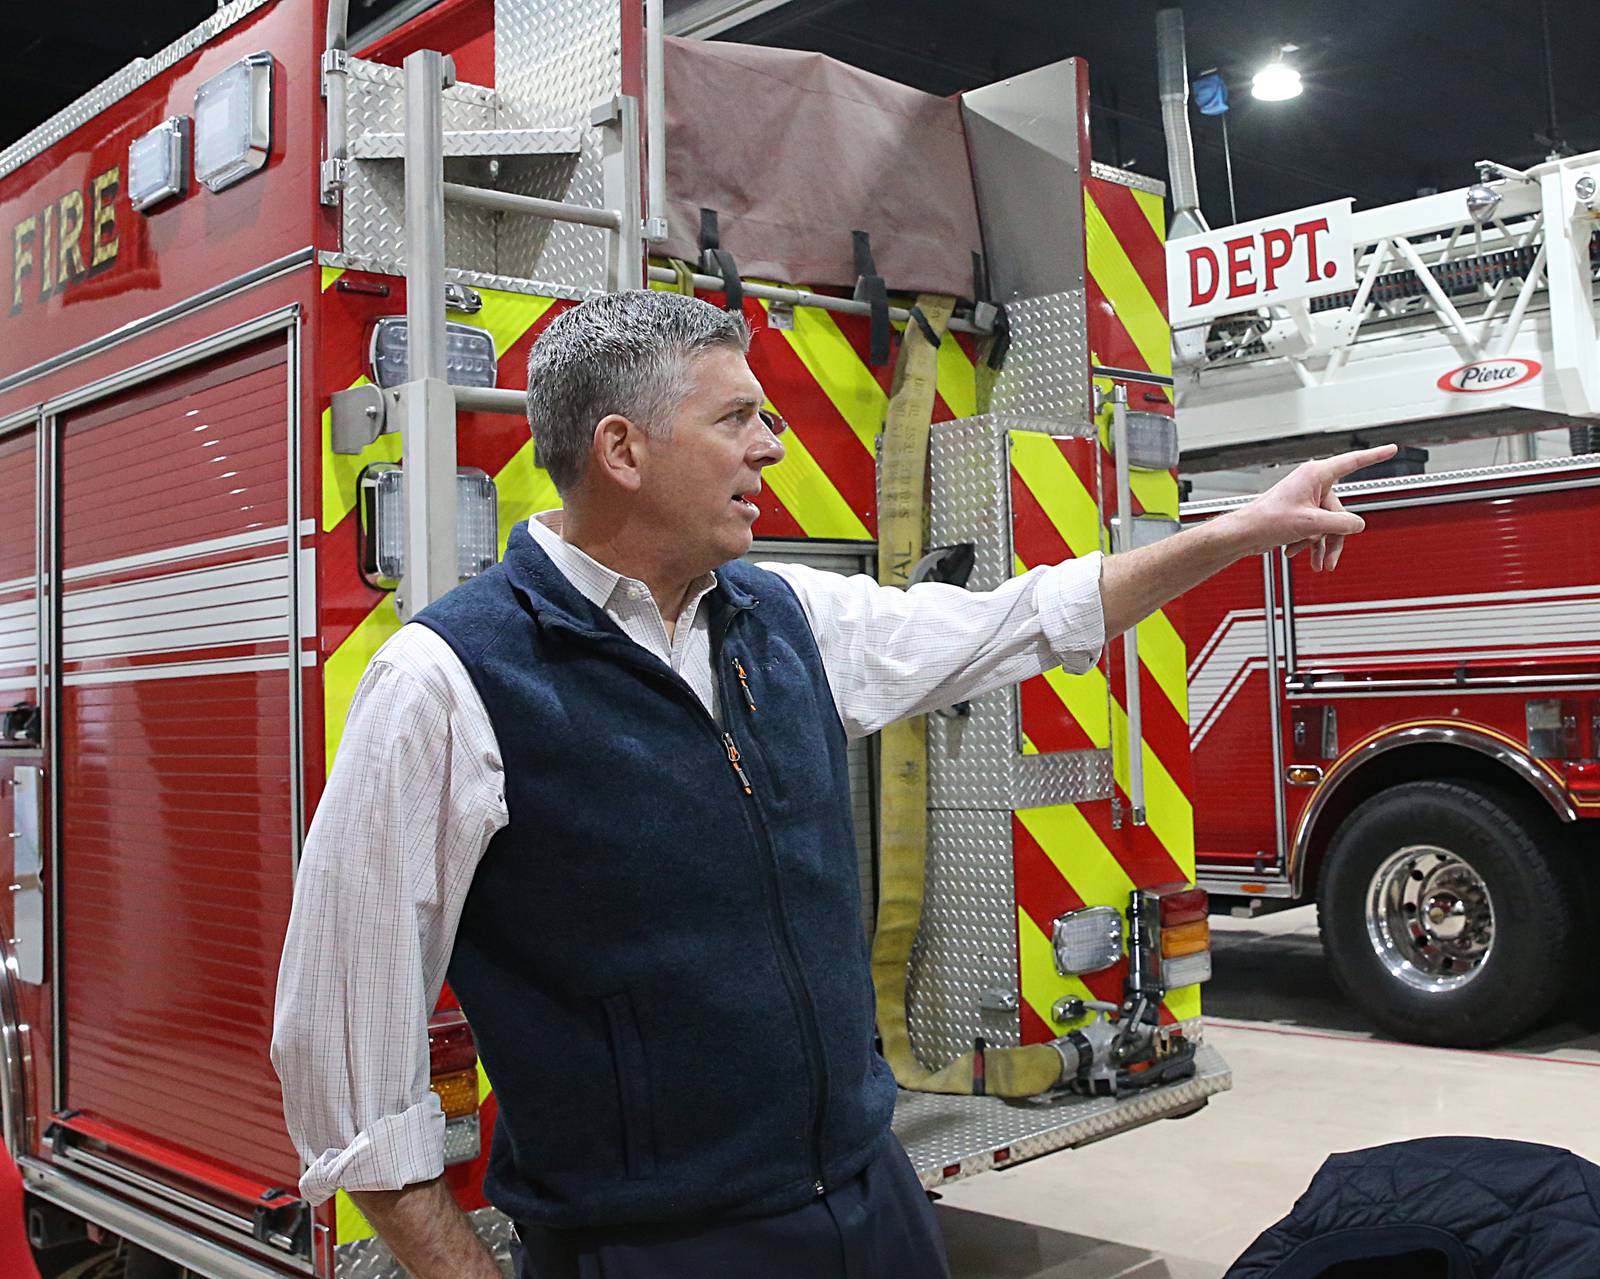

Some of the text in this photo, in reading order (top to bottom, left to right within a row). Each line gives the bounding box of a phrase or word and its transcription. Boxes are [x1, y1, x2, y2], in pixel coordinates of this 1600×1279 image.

[11, 167, 120, 314] FIRE
[1187, 217, 1337, 308] DEPT.
[1460, 365, 1516, 388] Pierce
